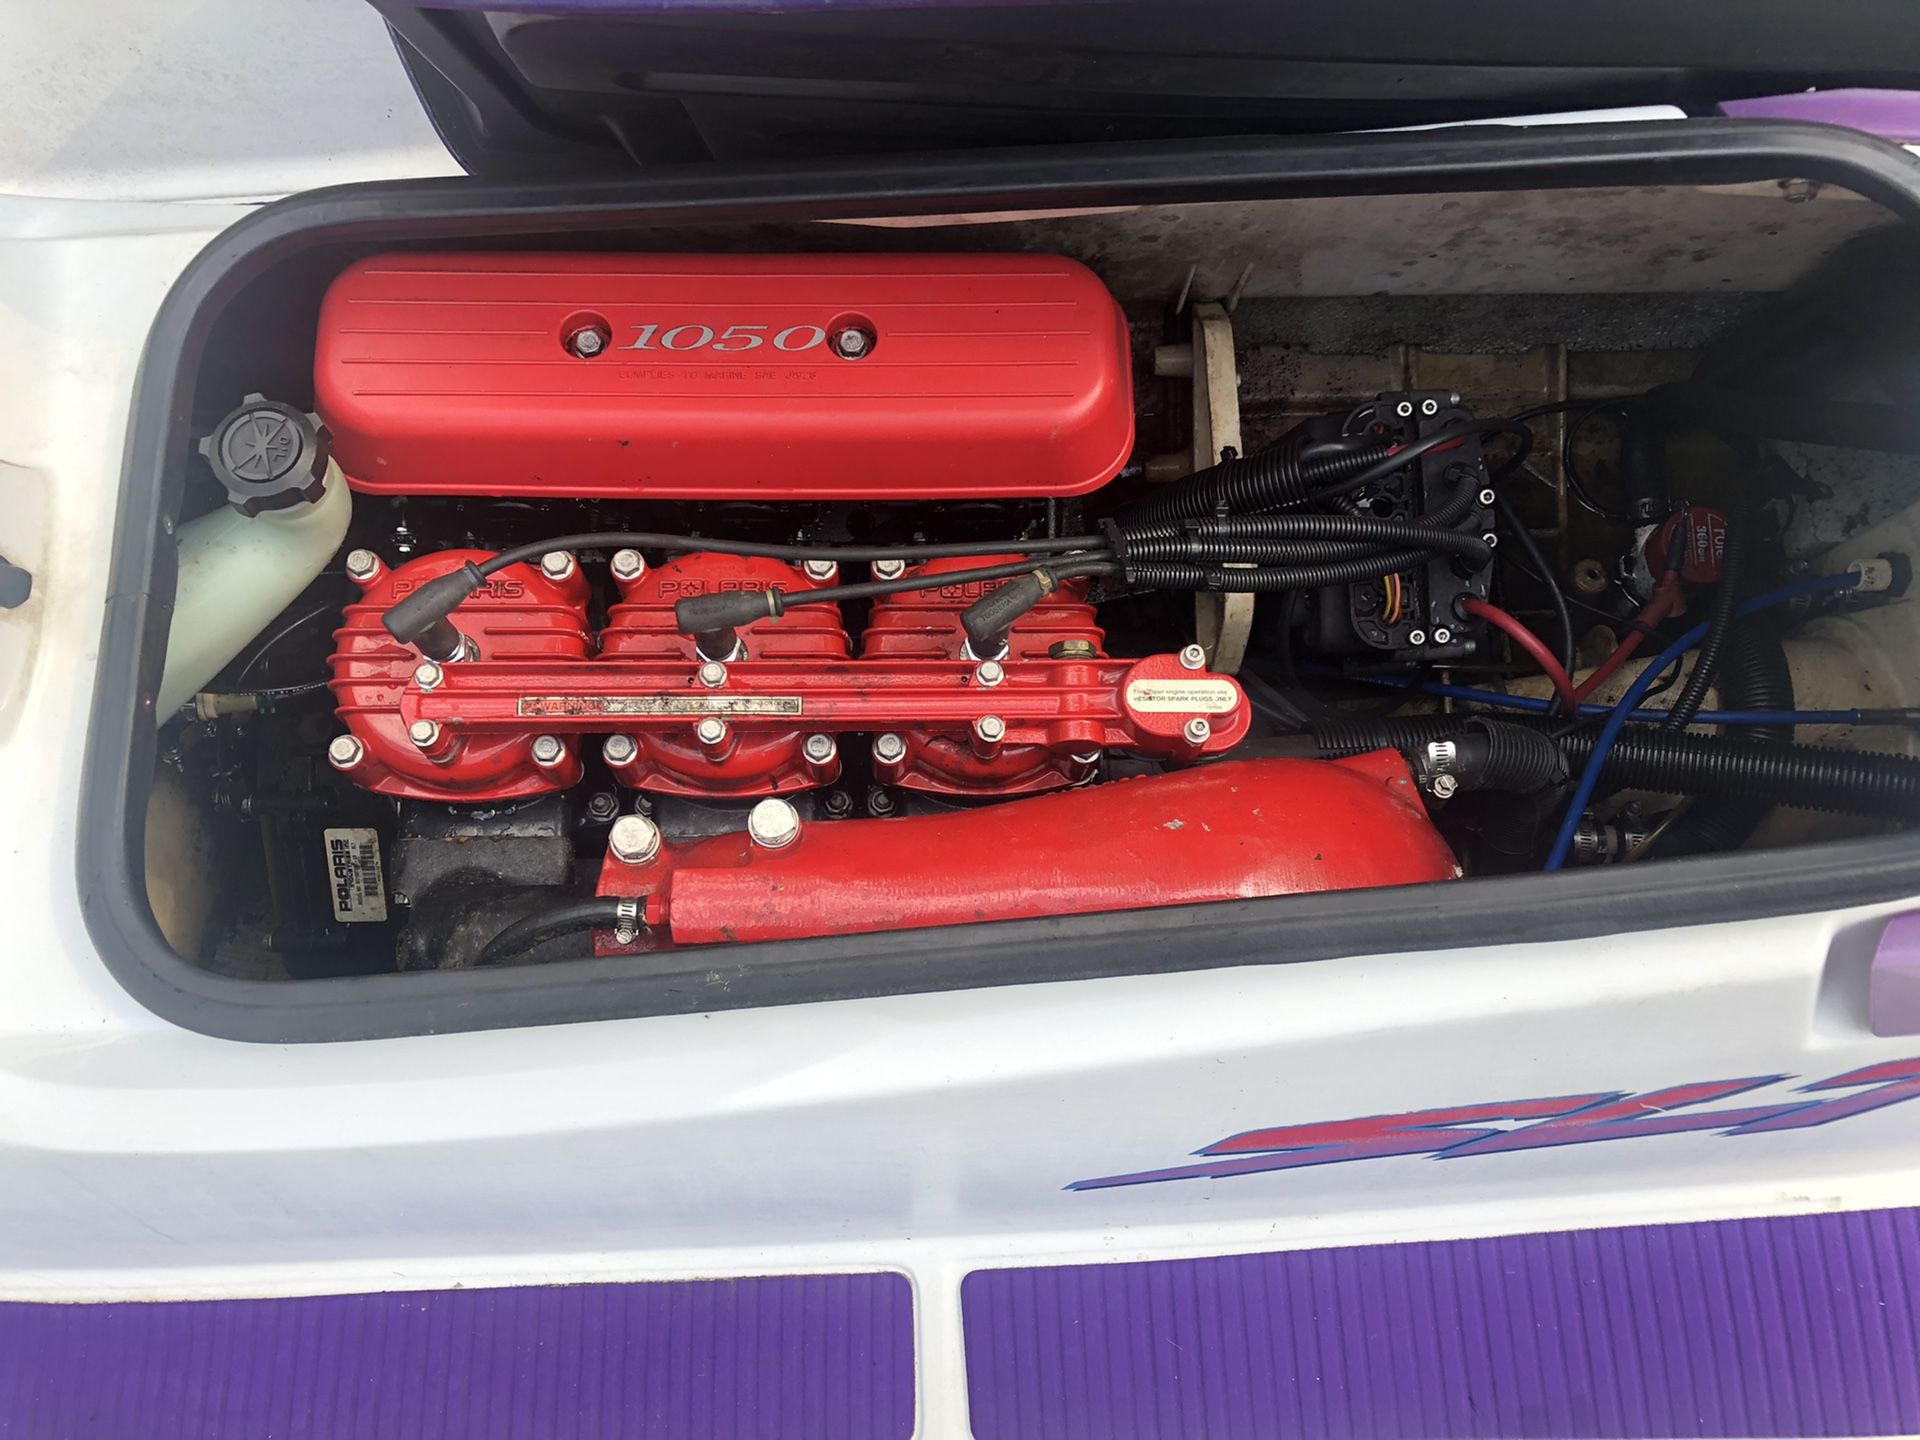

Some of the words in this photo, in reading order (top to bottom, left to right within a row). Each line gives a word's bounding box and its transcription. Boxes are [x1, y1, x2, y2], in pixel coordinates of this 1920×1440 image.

[617, 324, 826, 351] 1050
[273, 436, 291, 462] OIL
[392, 580, 524, 599] PRIS
[331, 839, 352, 911] POLARIS
